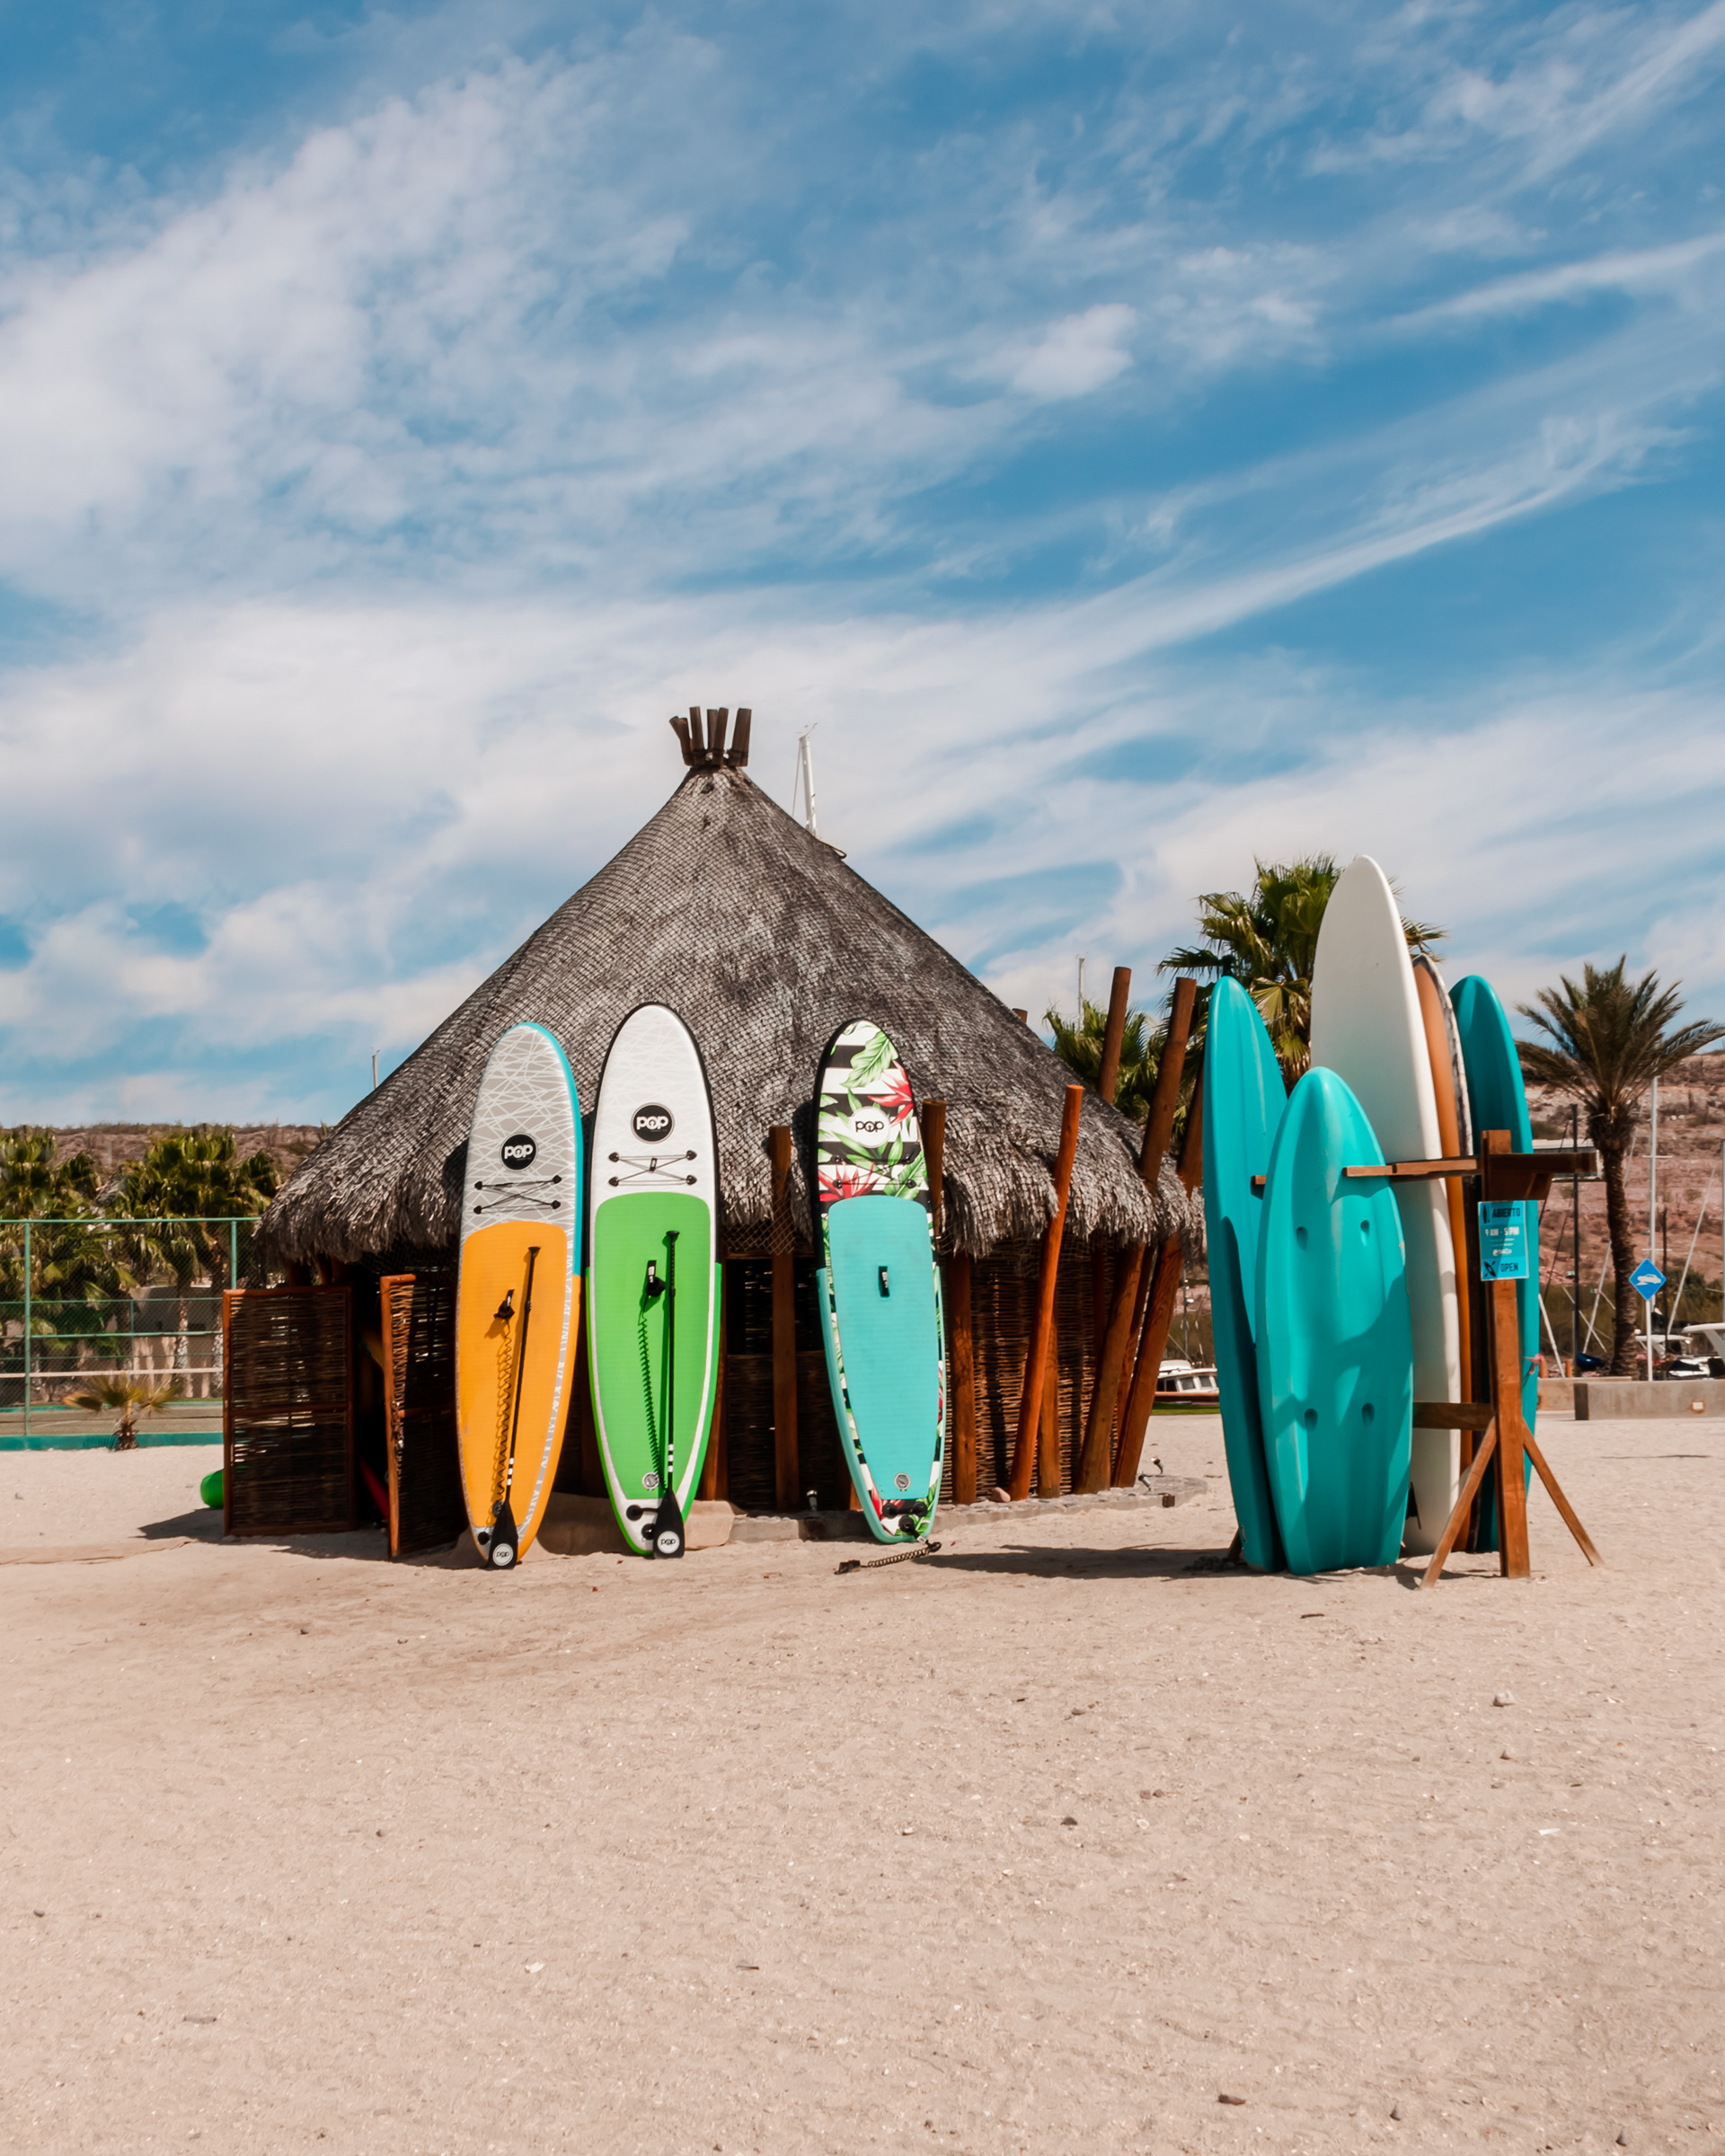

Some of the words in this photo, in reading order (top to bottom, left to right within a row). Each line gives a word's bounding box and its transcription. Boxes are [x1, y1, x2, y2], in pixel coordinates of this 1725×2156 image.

[1492, 1207, 1520, 1217] ABIERTO
[1490, 1228, 1499, 1236] AM
[1508, 1226, 1519, 1235] PM
[1501, 1263, 1518, 1272] OPEN
